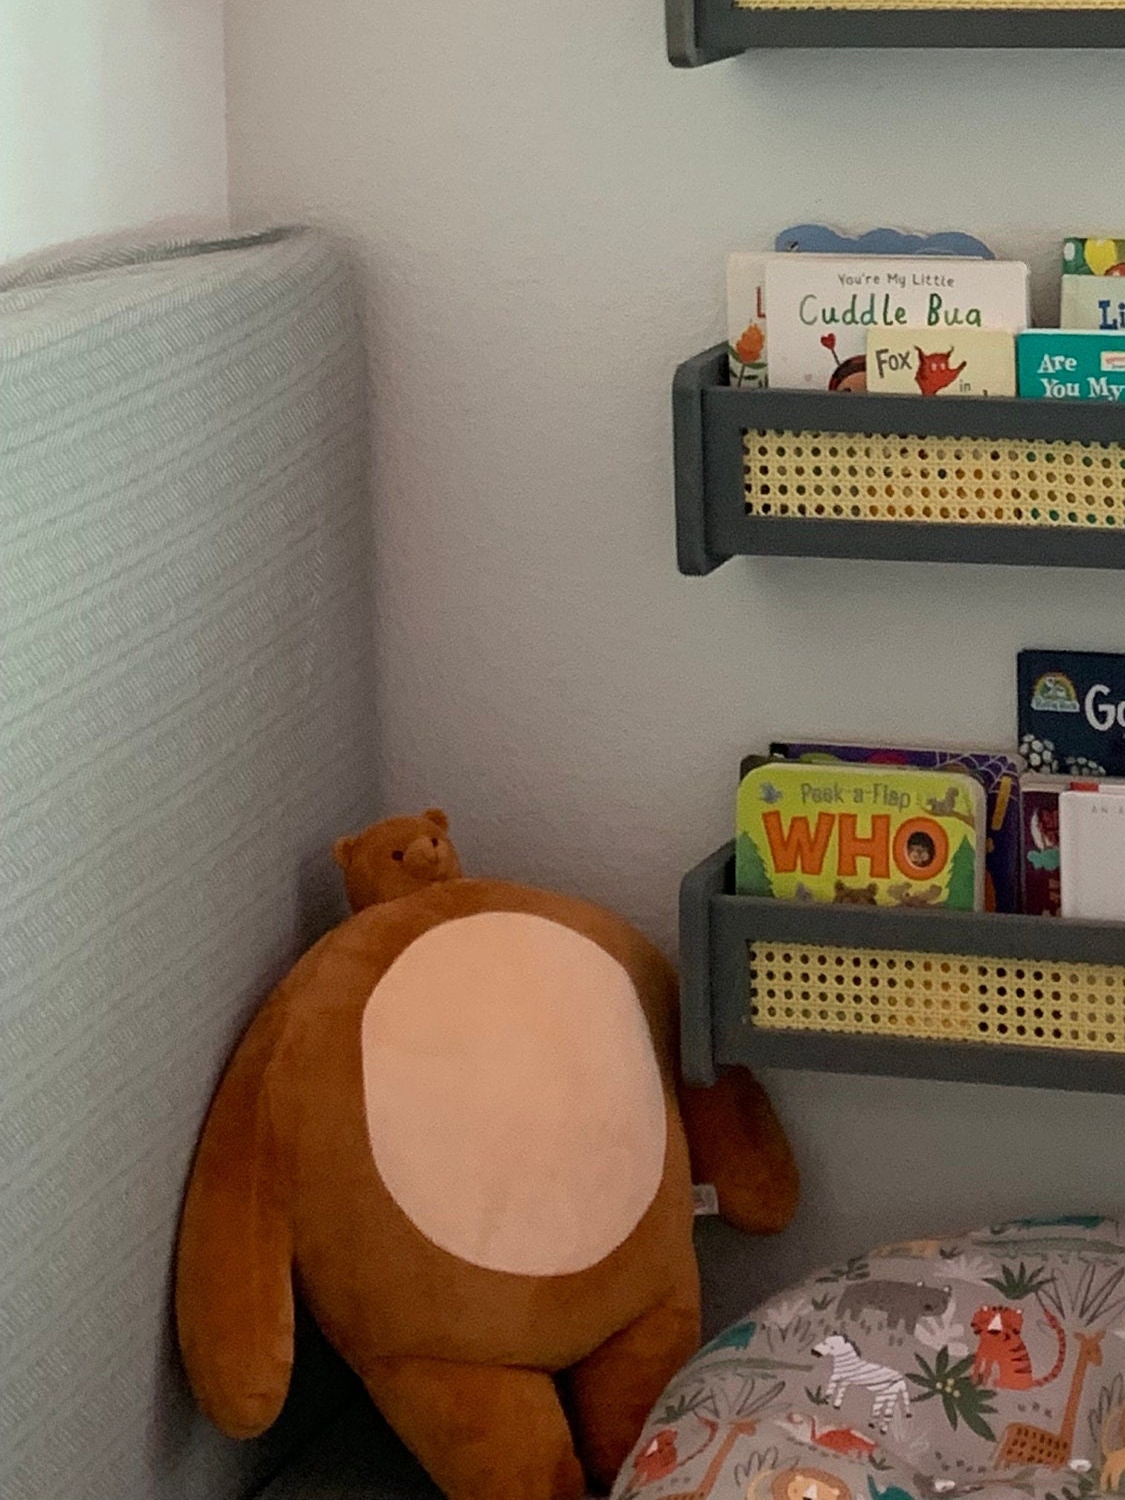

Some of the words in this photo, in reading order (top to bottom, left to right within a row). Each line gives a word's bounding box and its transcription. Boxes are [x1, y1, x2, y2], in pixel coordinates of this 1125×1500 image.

[838, 273, 881, 288] You're
[887, 273, 906, 289] My
[912, 273, 955, 288] Little
[799, 293, 907, 327] Cuddle
[1037, 354, 1077, 374] Are
[1040, 378, 1081, 398] You
[1087, 376, 1125, 400] My
[761, 810, 950, 881] WHO
